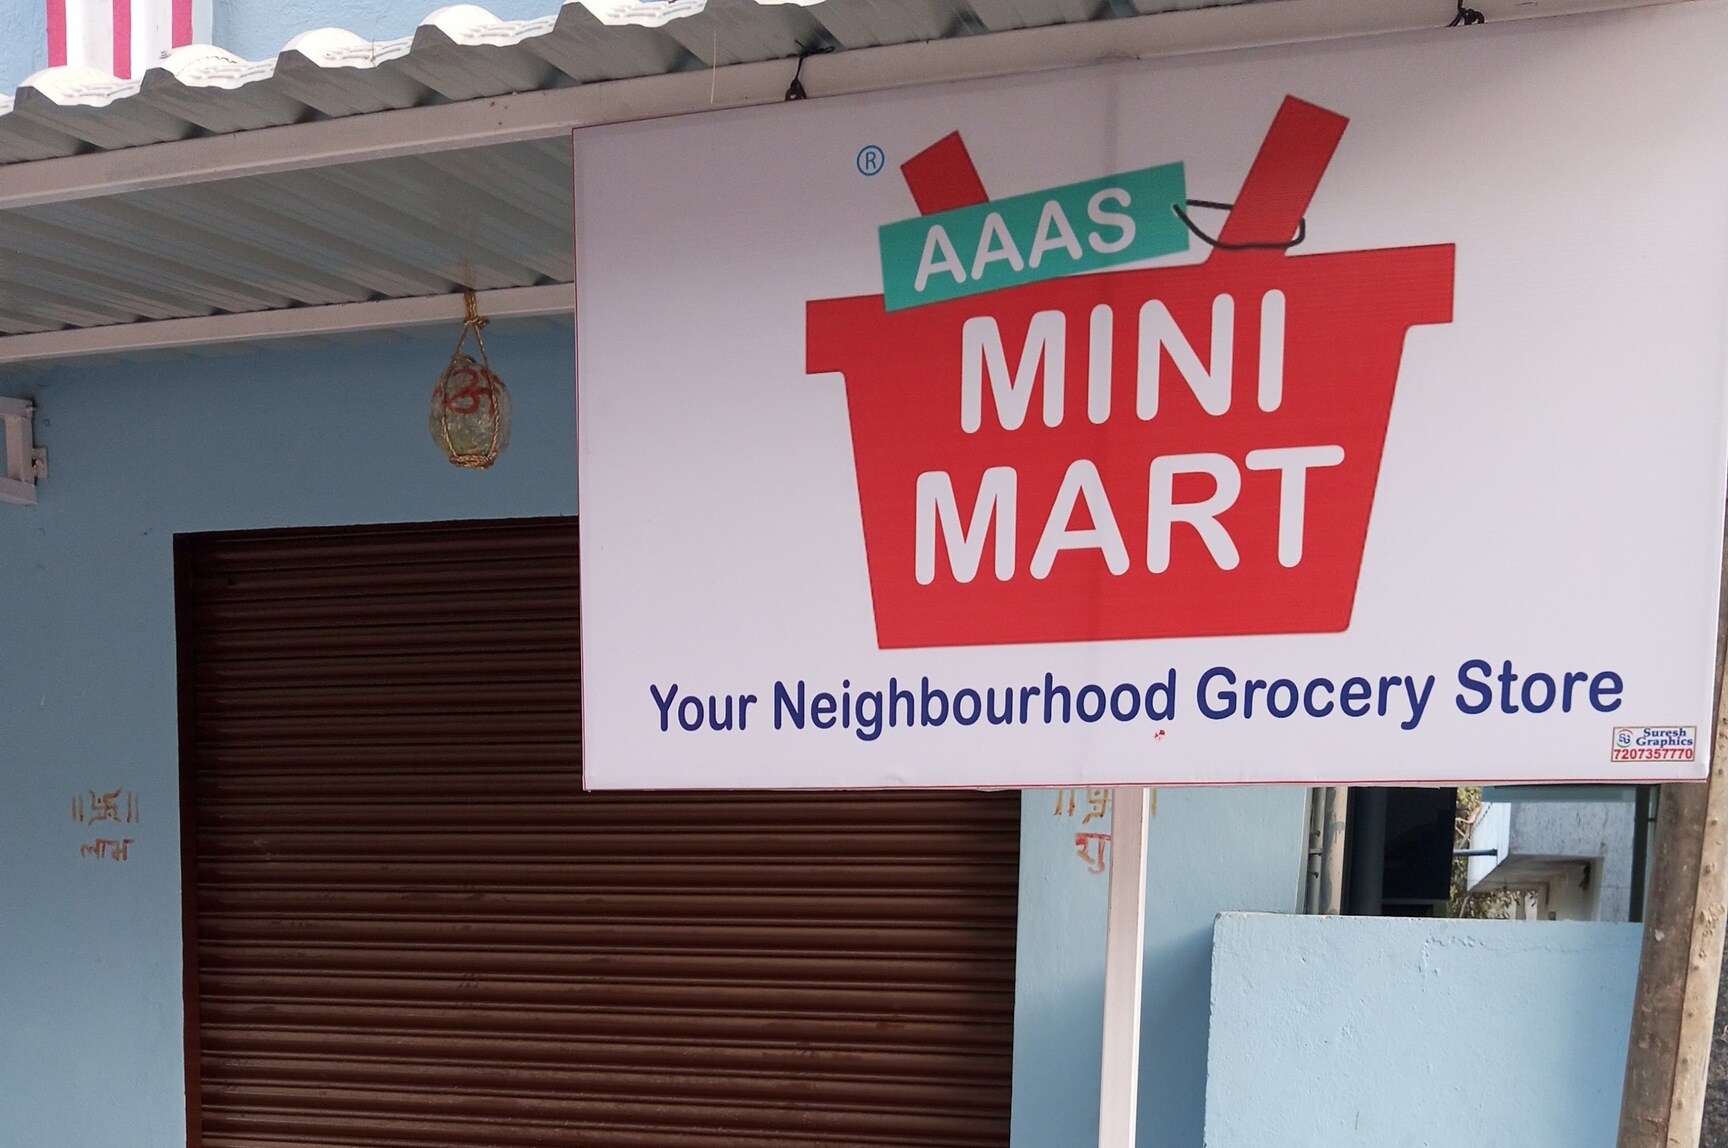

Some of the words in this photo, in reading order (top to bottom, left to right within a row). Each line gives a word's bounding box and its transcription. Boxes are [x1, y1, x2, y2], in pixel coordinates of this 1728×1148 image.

[914, 187, 1137, 292] AAAS
[961, 289, 1286, 434] MINI
[915, 445, 1345, 585] MART
[650, 683, 758, 732] Your
[773, 667, 1177, 742] Neighbourhood
[1196, 666, 1436, 731] Grocery
[1455, 659, 1624, 715] Store
[1636, 736, 1693, 748] Graphics
[1643, 728, 1686, 737] Suresh
[1614, 749, 1693, 759] 7207357770
